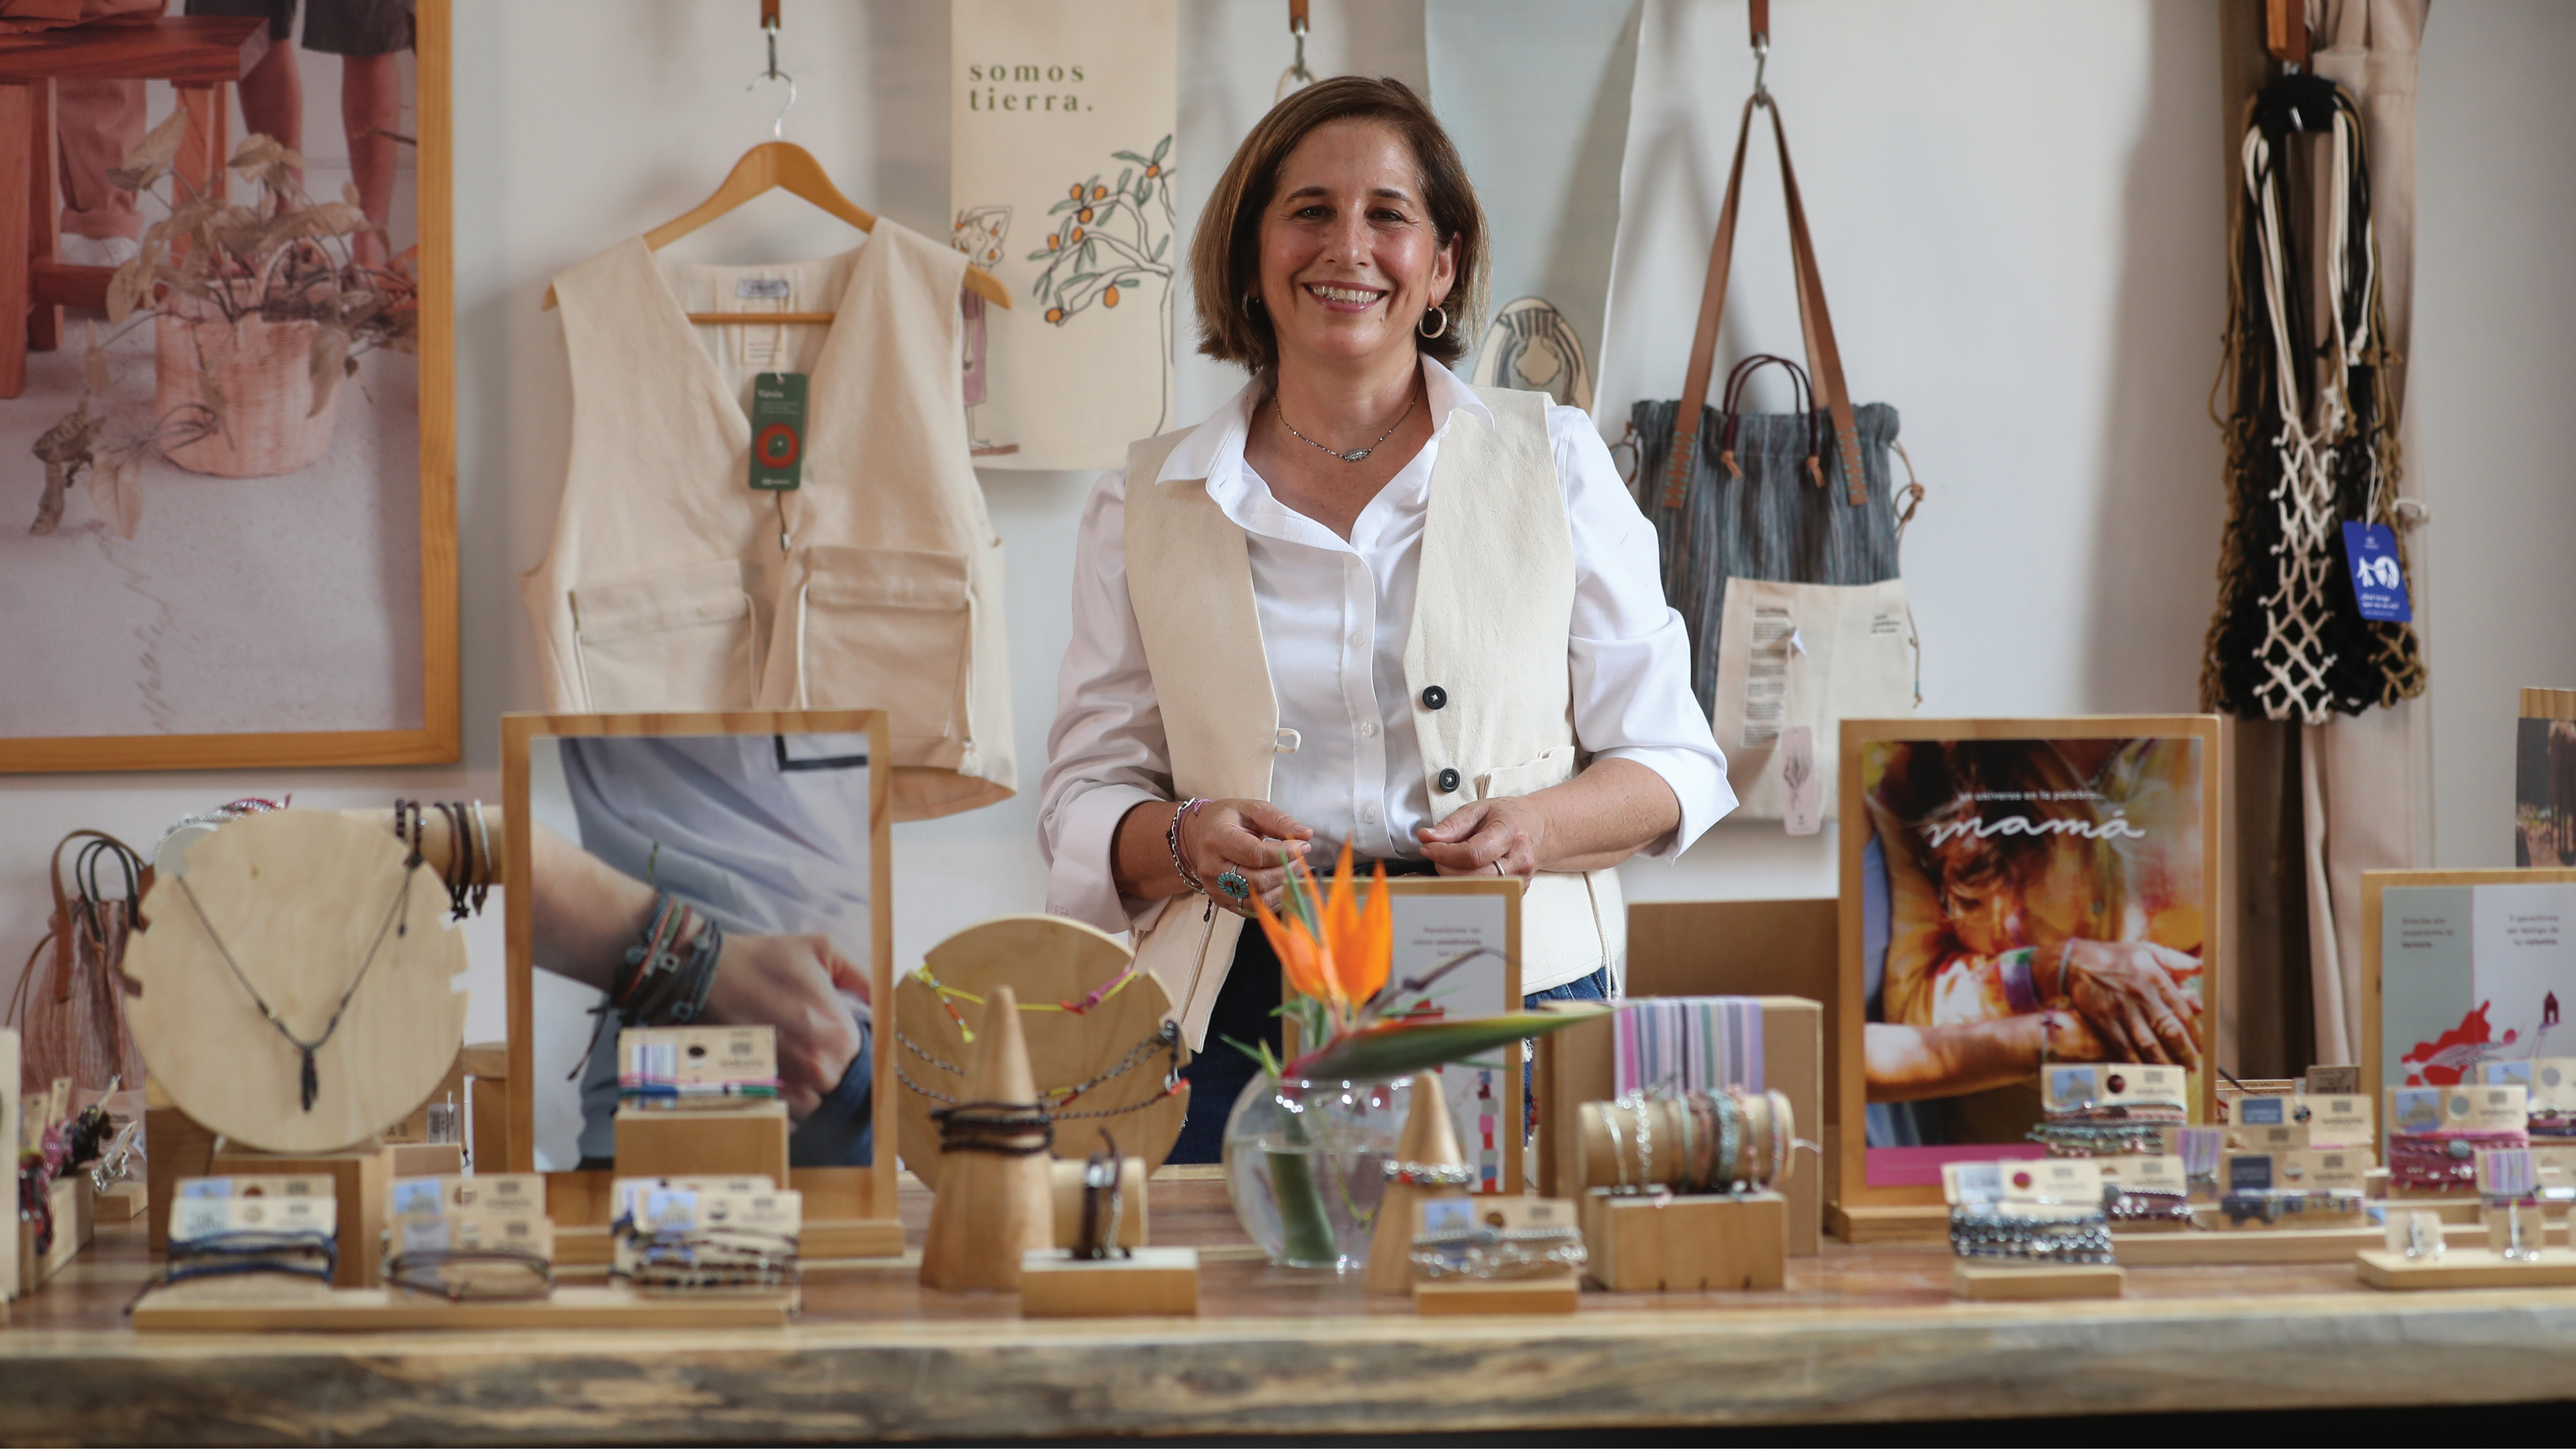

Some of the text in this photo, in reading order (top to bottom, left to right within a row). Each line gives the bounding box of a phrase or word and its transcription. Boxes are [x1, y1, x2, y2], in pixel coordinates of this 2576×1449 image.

[968, 64, 1085, 82] somos
[969, 86, 1093, 112] tierra.
[1974, 790, 2021, 801] universo
[2023, 791, 2037, 801] en
[2039, 789, 2050, 800] la
[1929, 809, 2146, 848] mamá
